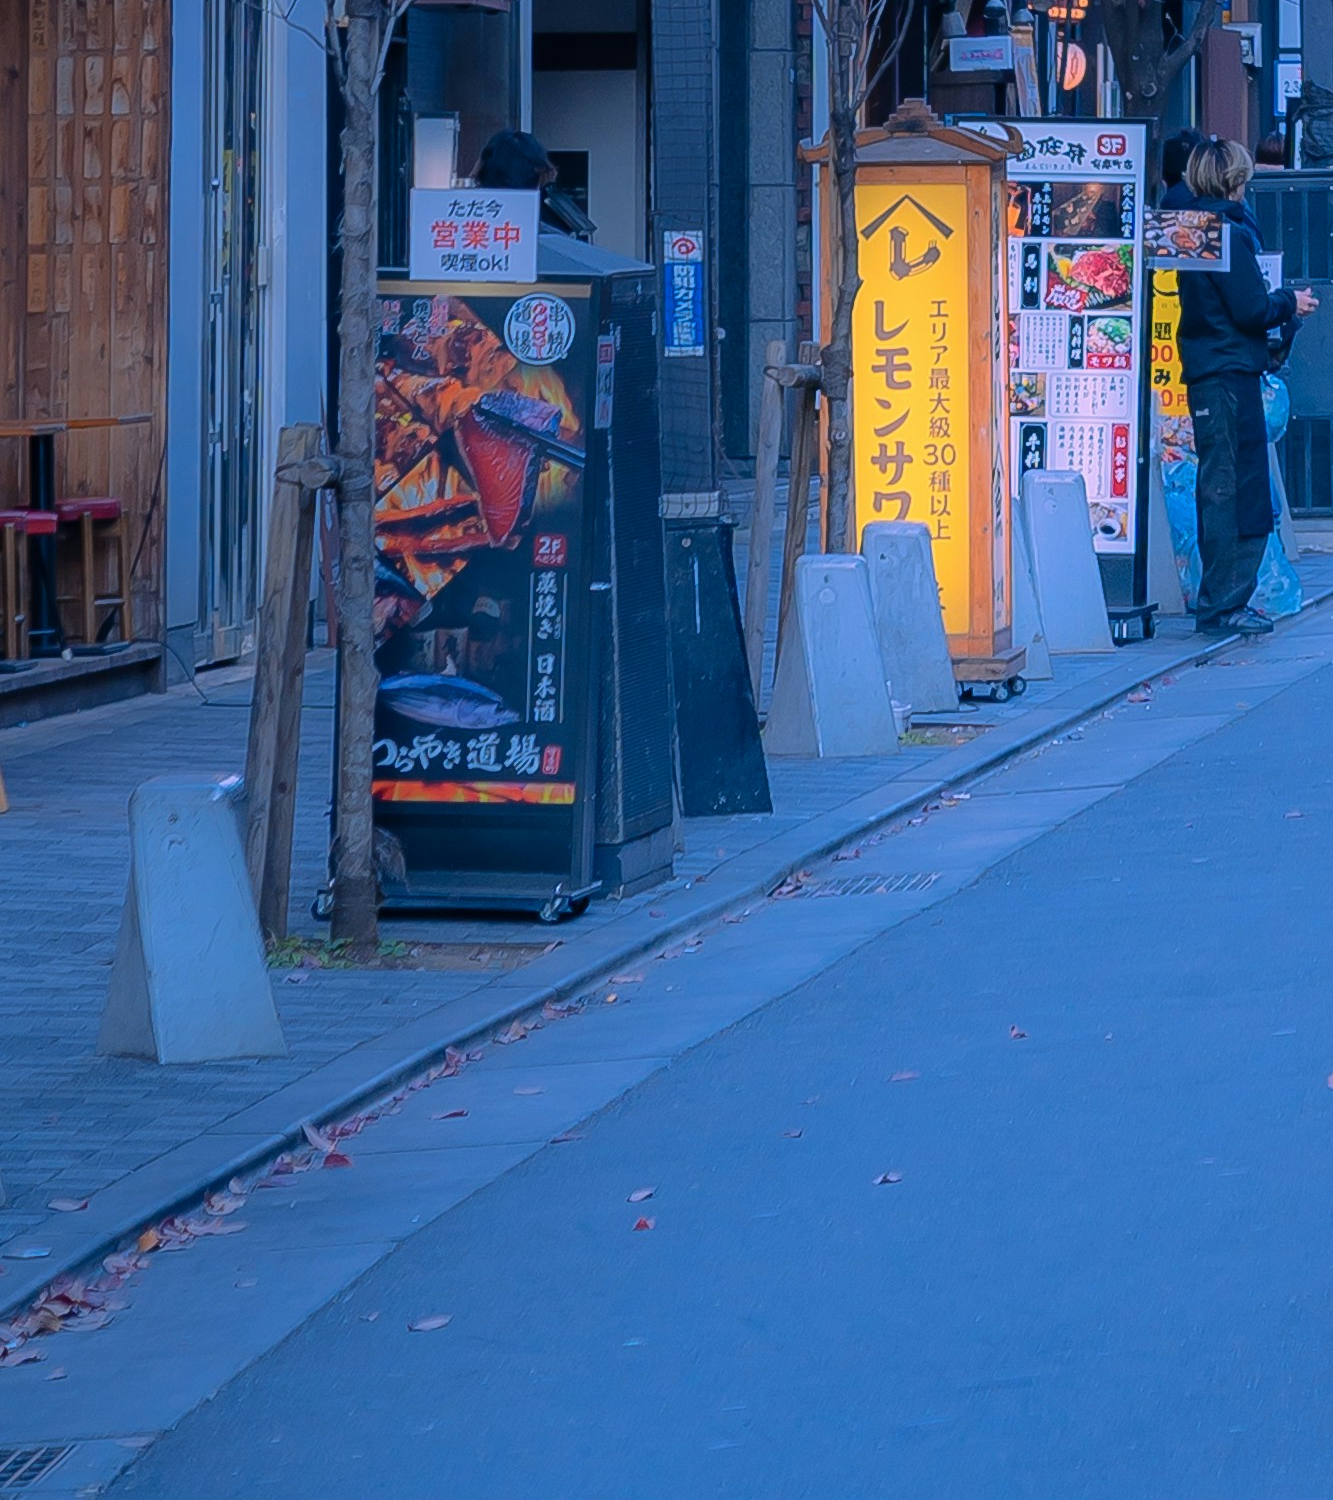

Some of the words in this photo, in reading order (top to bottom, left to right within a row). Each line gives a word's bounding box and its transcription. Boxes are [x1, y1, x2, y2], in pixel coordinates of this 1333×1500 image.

[1101, 137, 1123, 154] 3F
[448, 199, 503, 218] ただ今
[431, 220, 521, 250] 営業中
[441, 252, 509, 272] 喫煙ok!
[922, 299, 957, 542] エリア最大級30種以上
[538, 535, 562, 555] 2F
[534, 652, 557, 723] 日本酒
